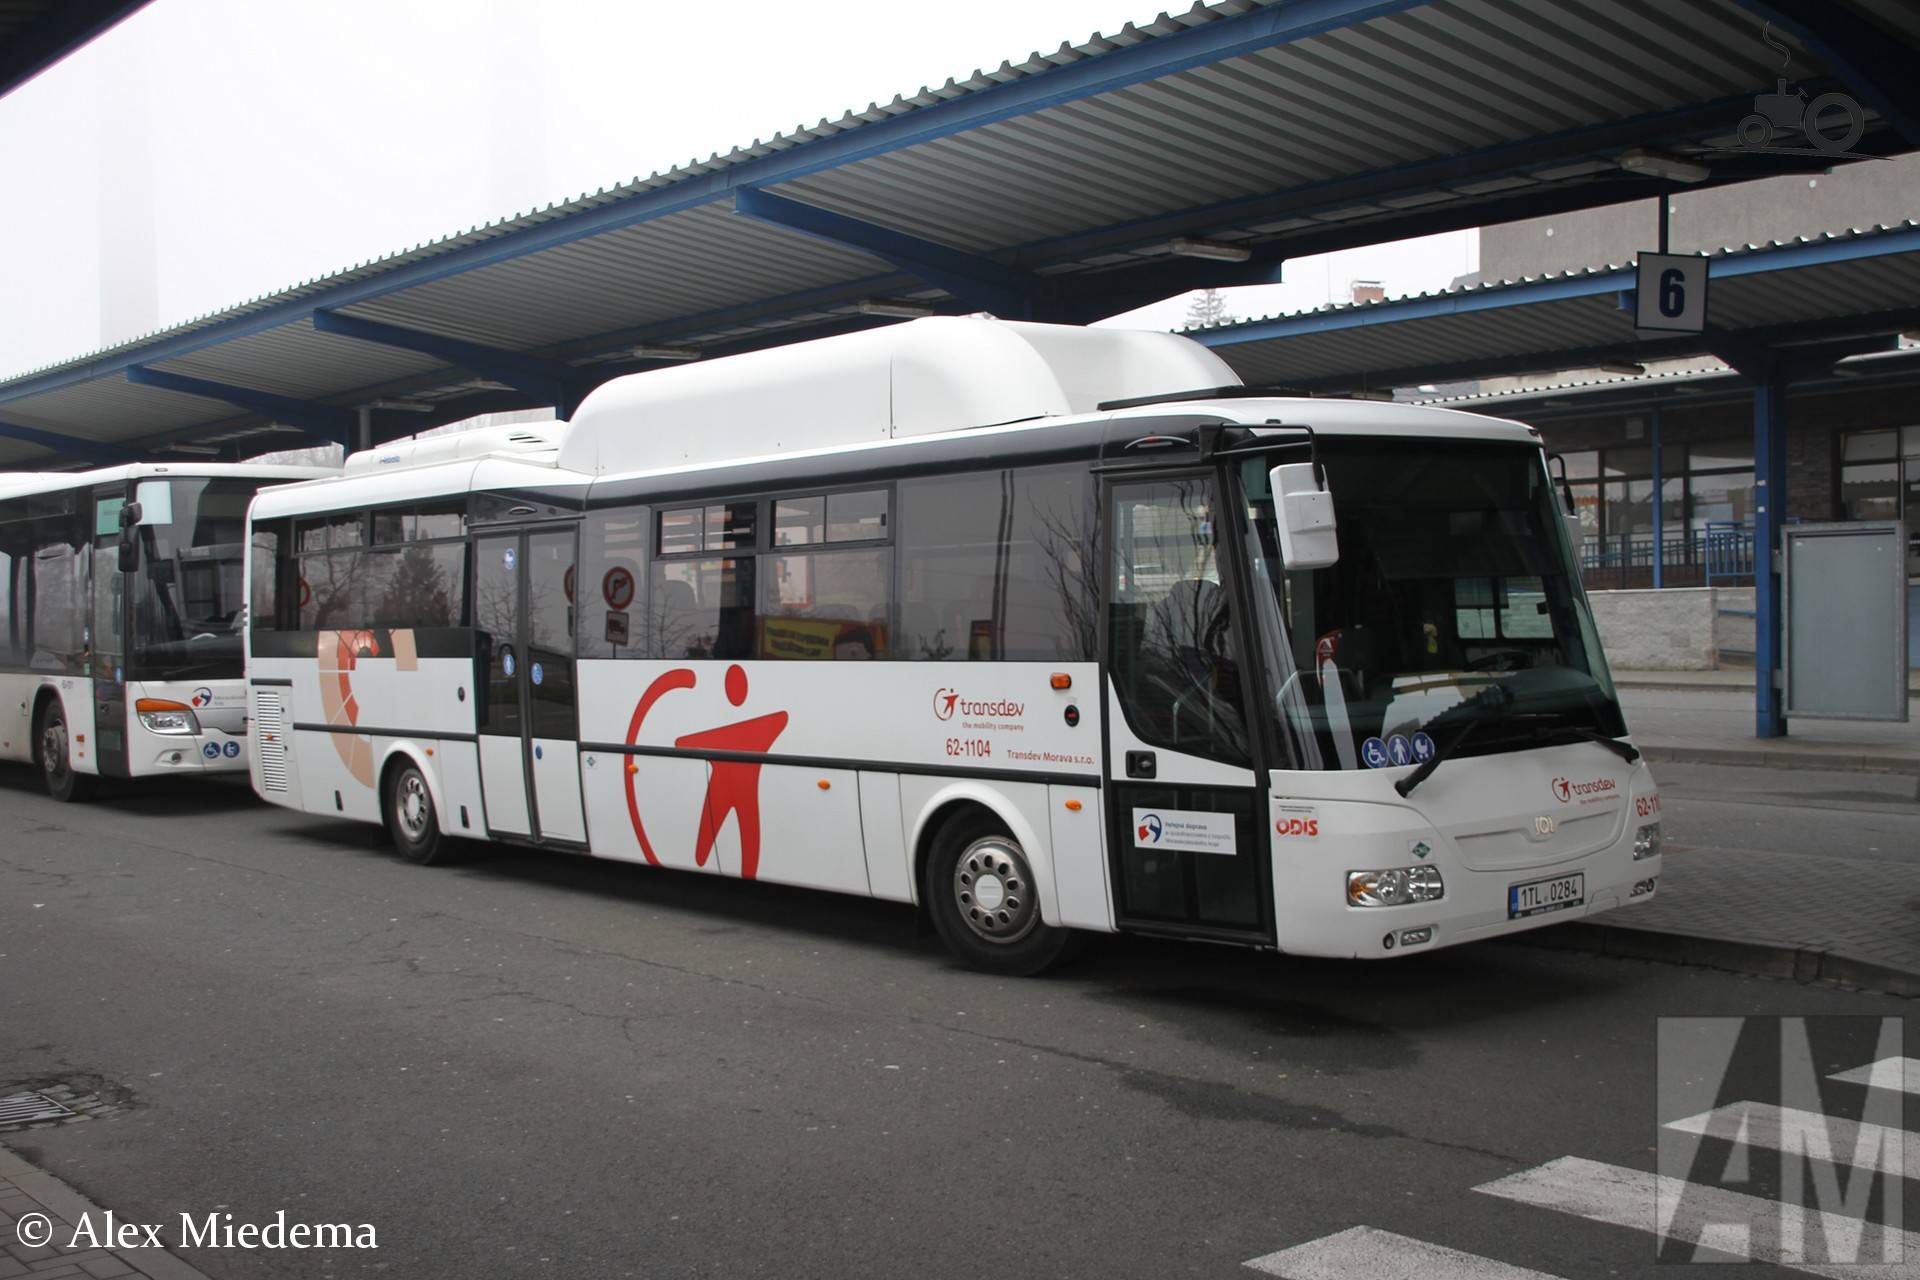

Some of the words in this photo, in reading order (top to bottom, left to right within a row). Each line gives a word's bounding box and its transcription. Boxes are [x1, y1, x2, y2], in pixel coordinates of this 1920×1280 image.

[1660, 268, 1685, 318] 6
[960, 699, 1024, 717] transdev
[946, 738, 991, 757] 62-1104
[1007, 750, 1041, 761] Transdev
[1043, 752, 1073, 763] Morava
[1572, 778, 1616, 795] transdev
[1521, 886, 1542, 907] 1TL
[1550, 879, 1577, 901] 0284
